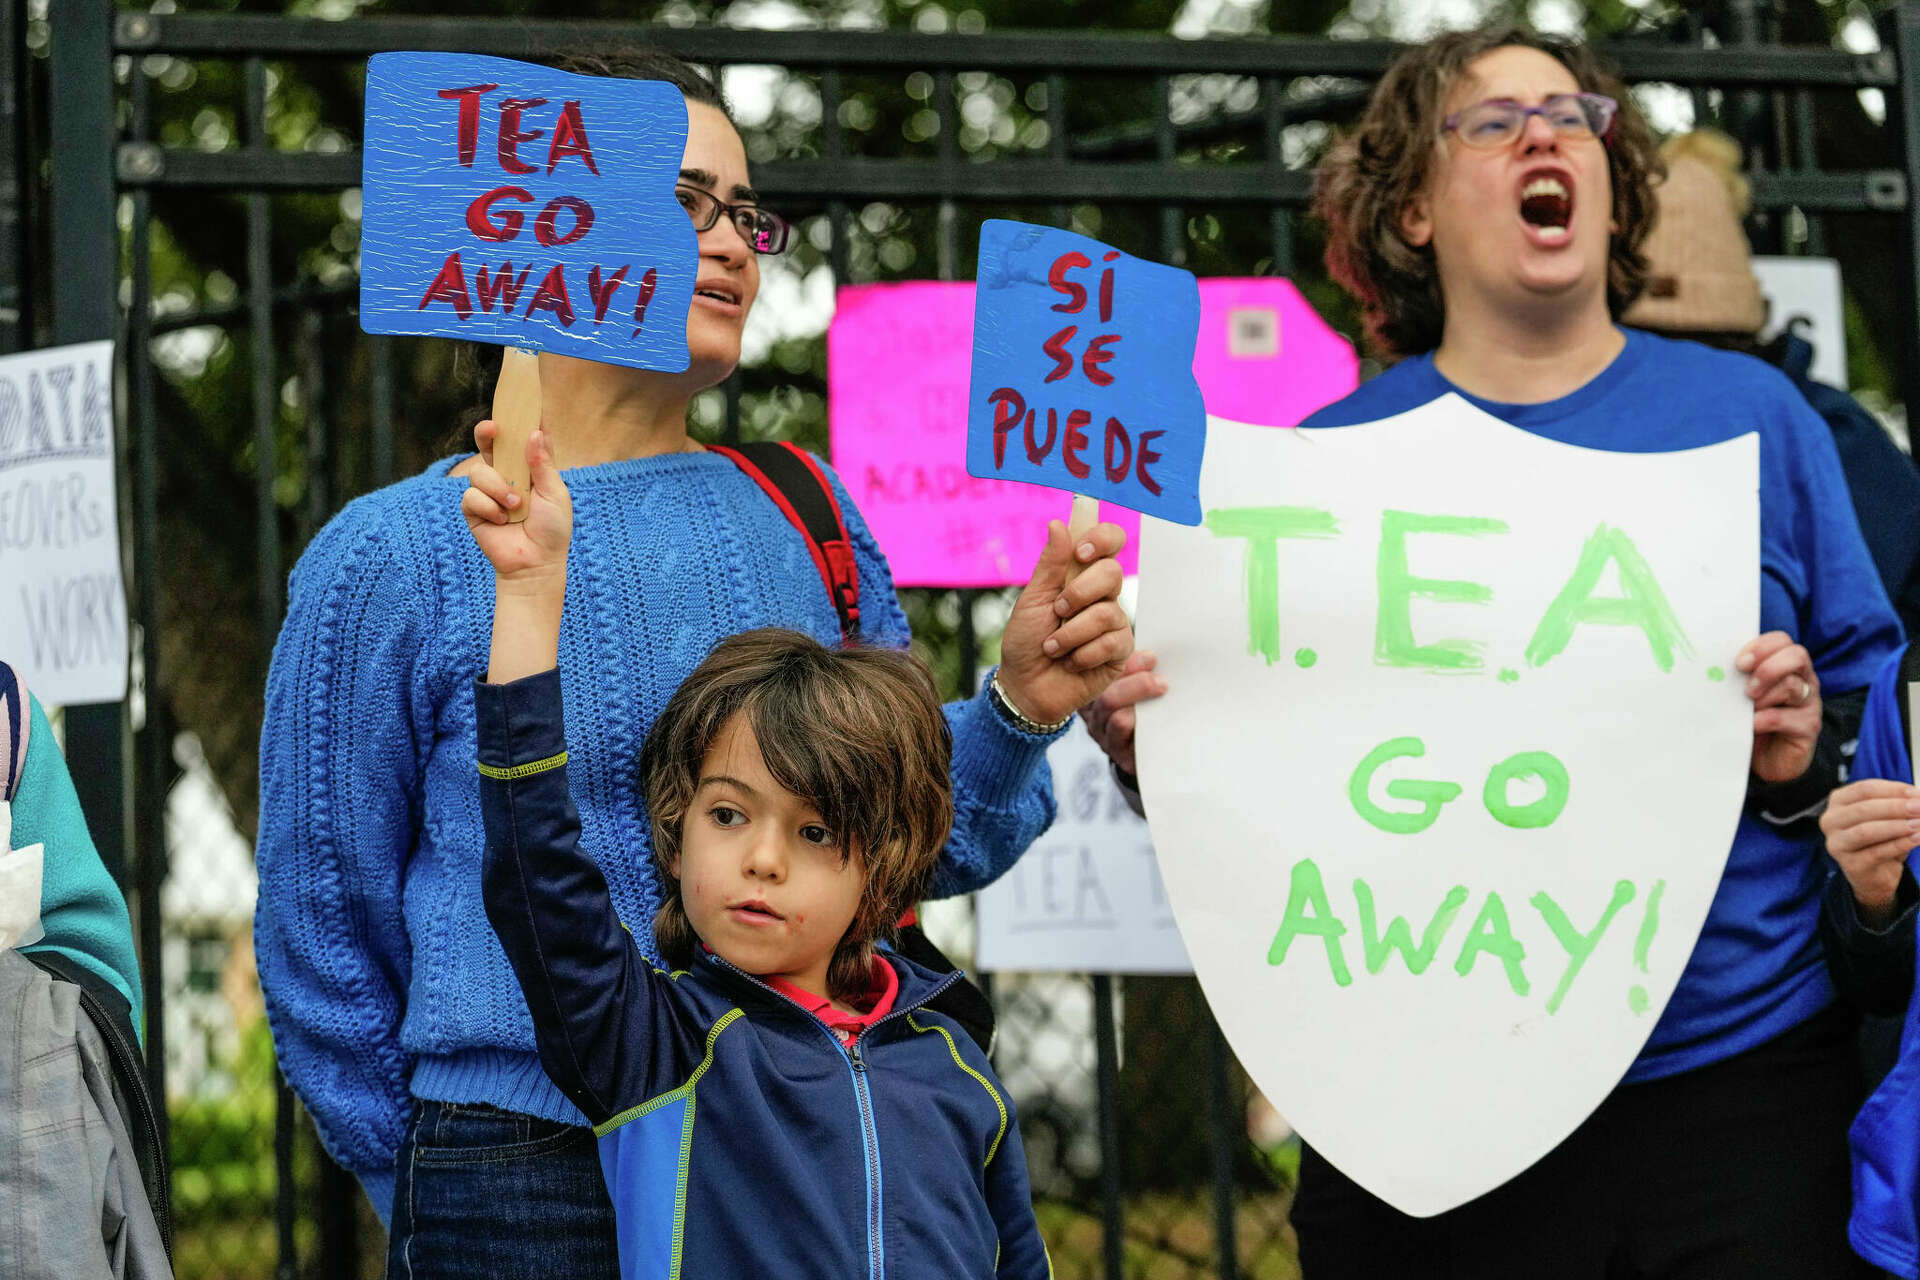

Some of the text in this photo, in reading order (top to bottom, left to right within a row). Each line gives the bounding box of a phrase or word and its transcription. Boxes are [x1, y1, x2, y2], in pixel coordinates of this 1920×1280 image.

[438, 83, 600, 176] TEA
[466, 186, 595, 247] GO
[418, 252, 657, 339] AWAY!
[1043, 325, 1122, 387] SE
[988, 387, 1167, 497] PUEDE
[1205, 505, 1725, 684] T.E.A.
[1347, 736, 1571, 835] GO
[1266, 857, 1666, 1017] AWAY!
